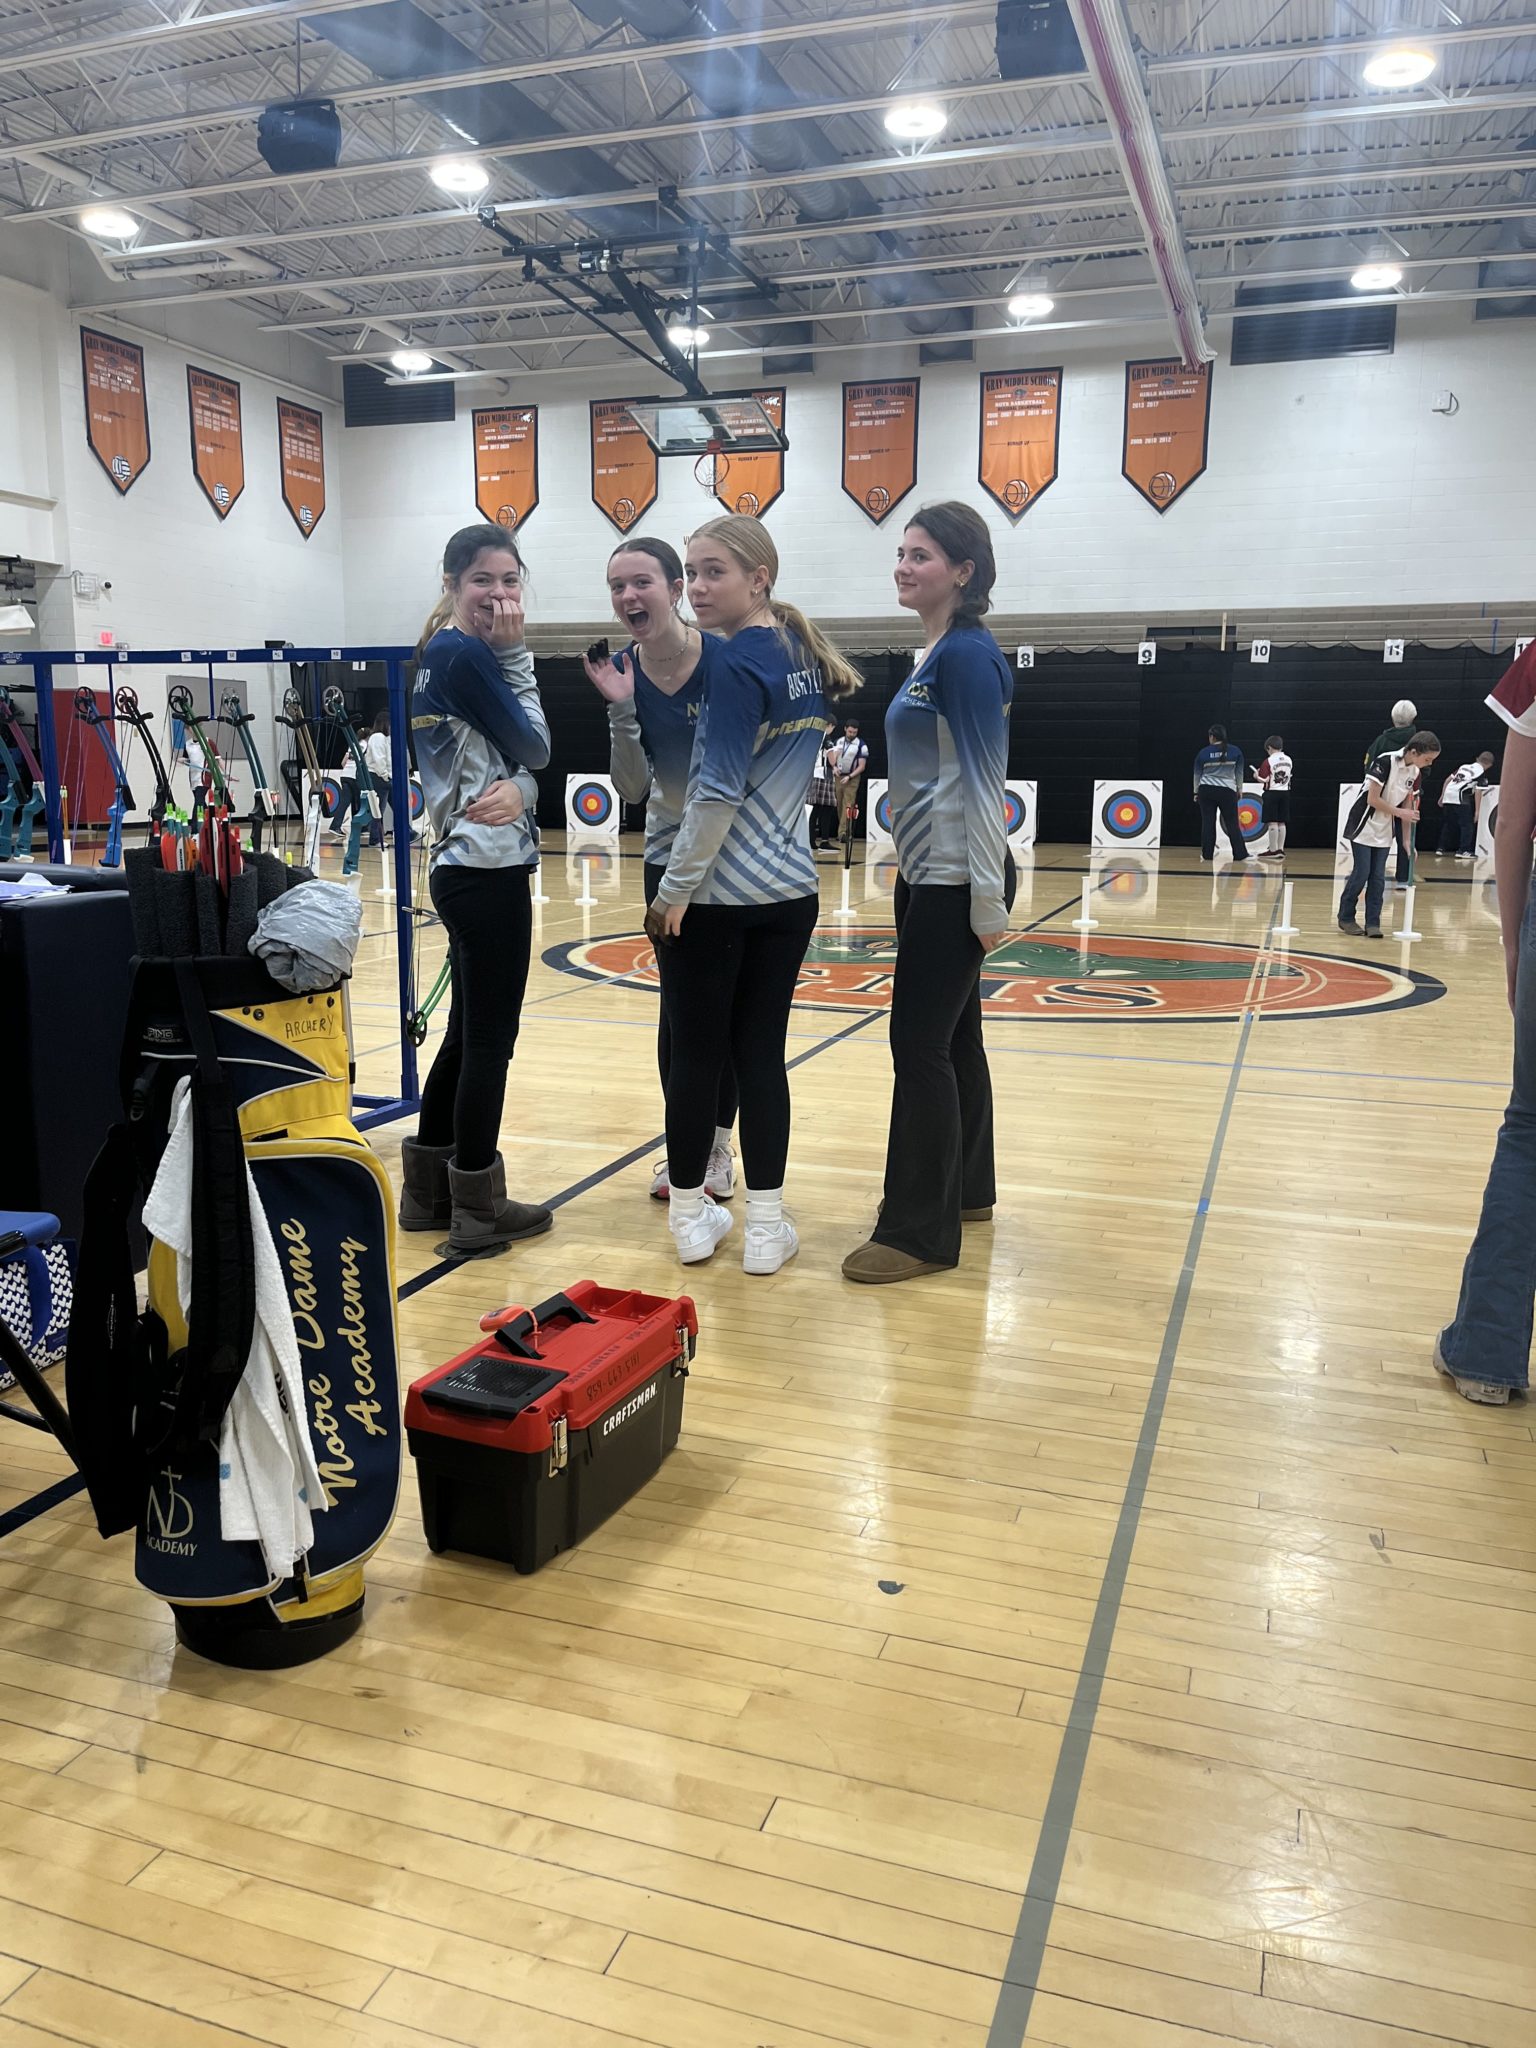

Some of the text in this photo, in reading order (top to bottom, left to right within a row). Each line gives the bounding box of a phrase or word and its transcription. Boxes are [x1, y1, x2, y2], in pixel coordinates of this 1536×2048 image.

[1132, 368, 1149, 381] GRAY
[1151, 365, 1177, 376] MIDDLE
[986, 374, 1056, 392] GRAY MIDDLE SCHOOL
[848, 384, 914, 401] GRAY MIDDLE SCHOOL
[1158, 388, 1196, 396] BASKETBALL
[491, 413, 511, 422] MIDDLE
[1020, 652, 1031, 667] 8
[1141, 649, 1153, 663] 9
[1254, 645, 1269, 657] 10
[285, 1014, 334, 1039] ARCHERY
[281, 1218, 325, 1352] Dame
[337, 1236, 388, 1437] Academy
[603, 1382, 657, 1436] CRAFTSMAN
[309, 1372, 357, 1508] Notre
[146, 1535, 198, 1557] ACADEMY
